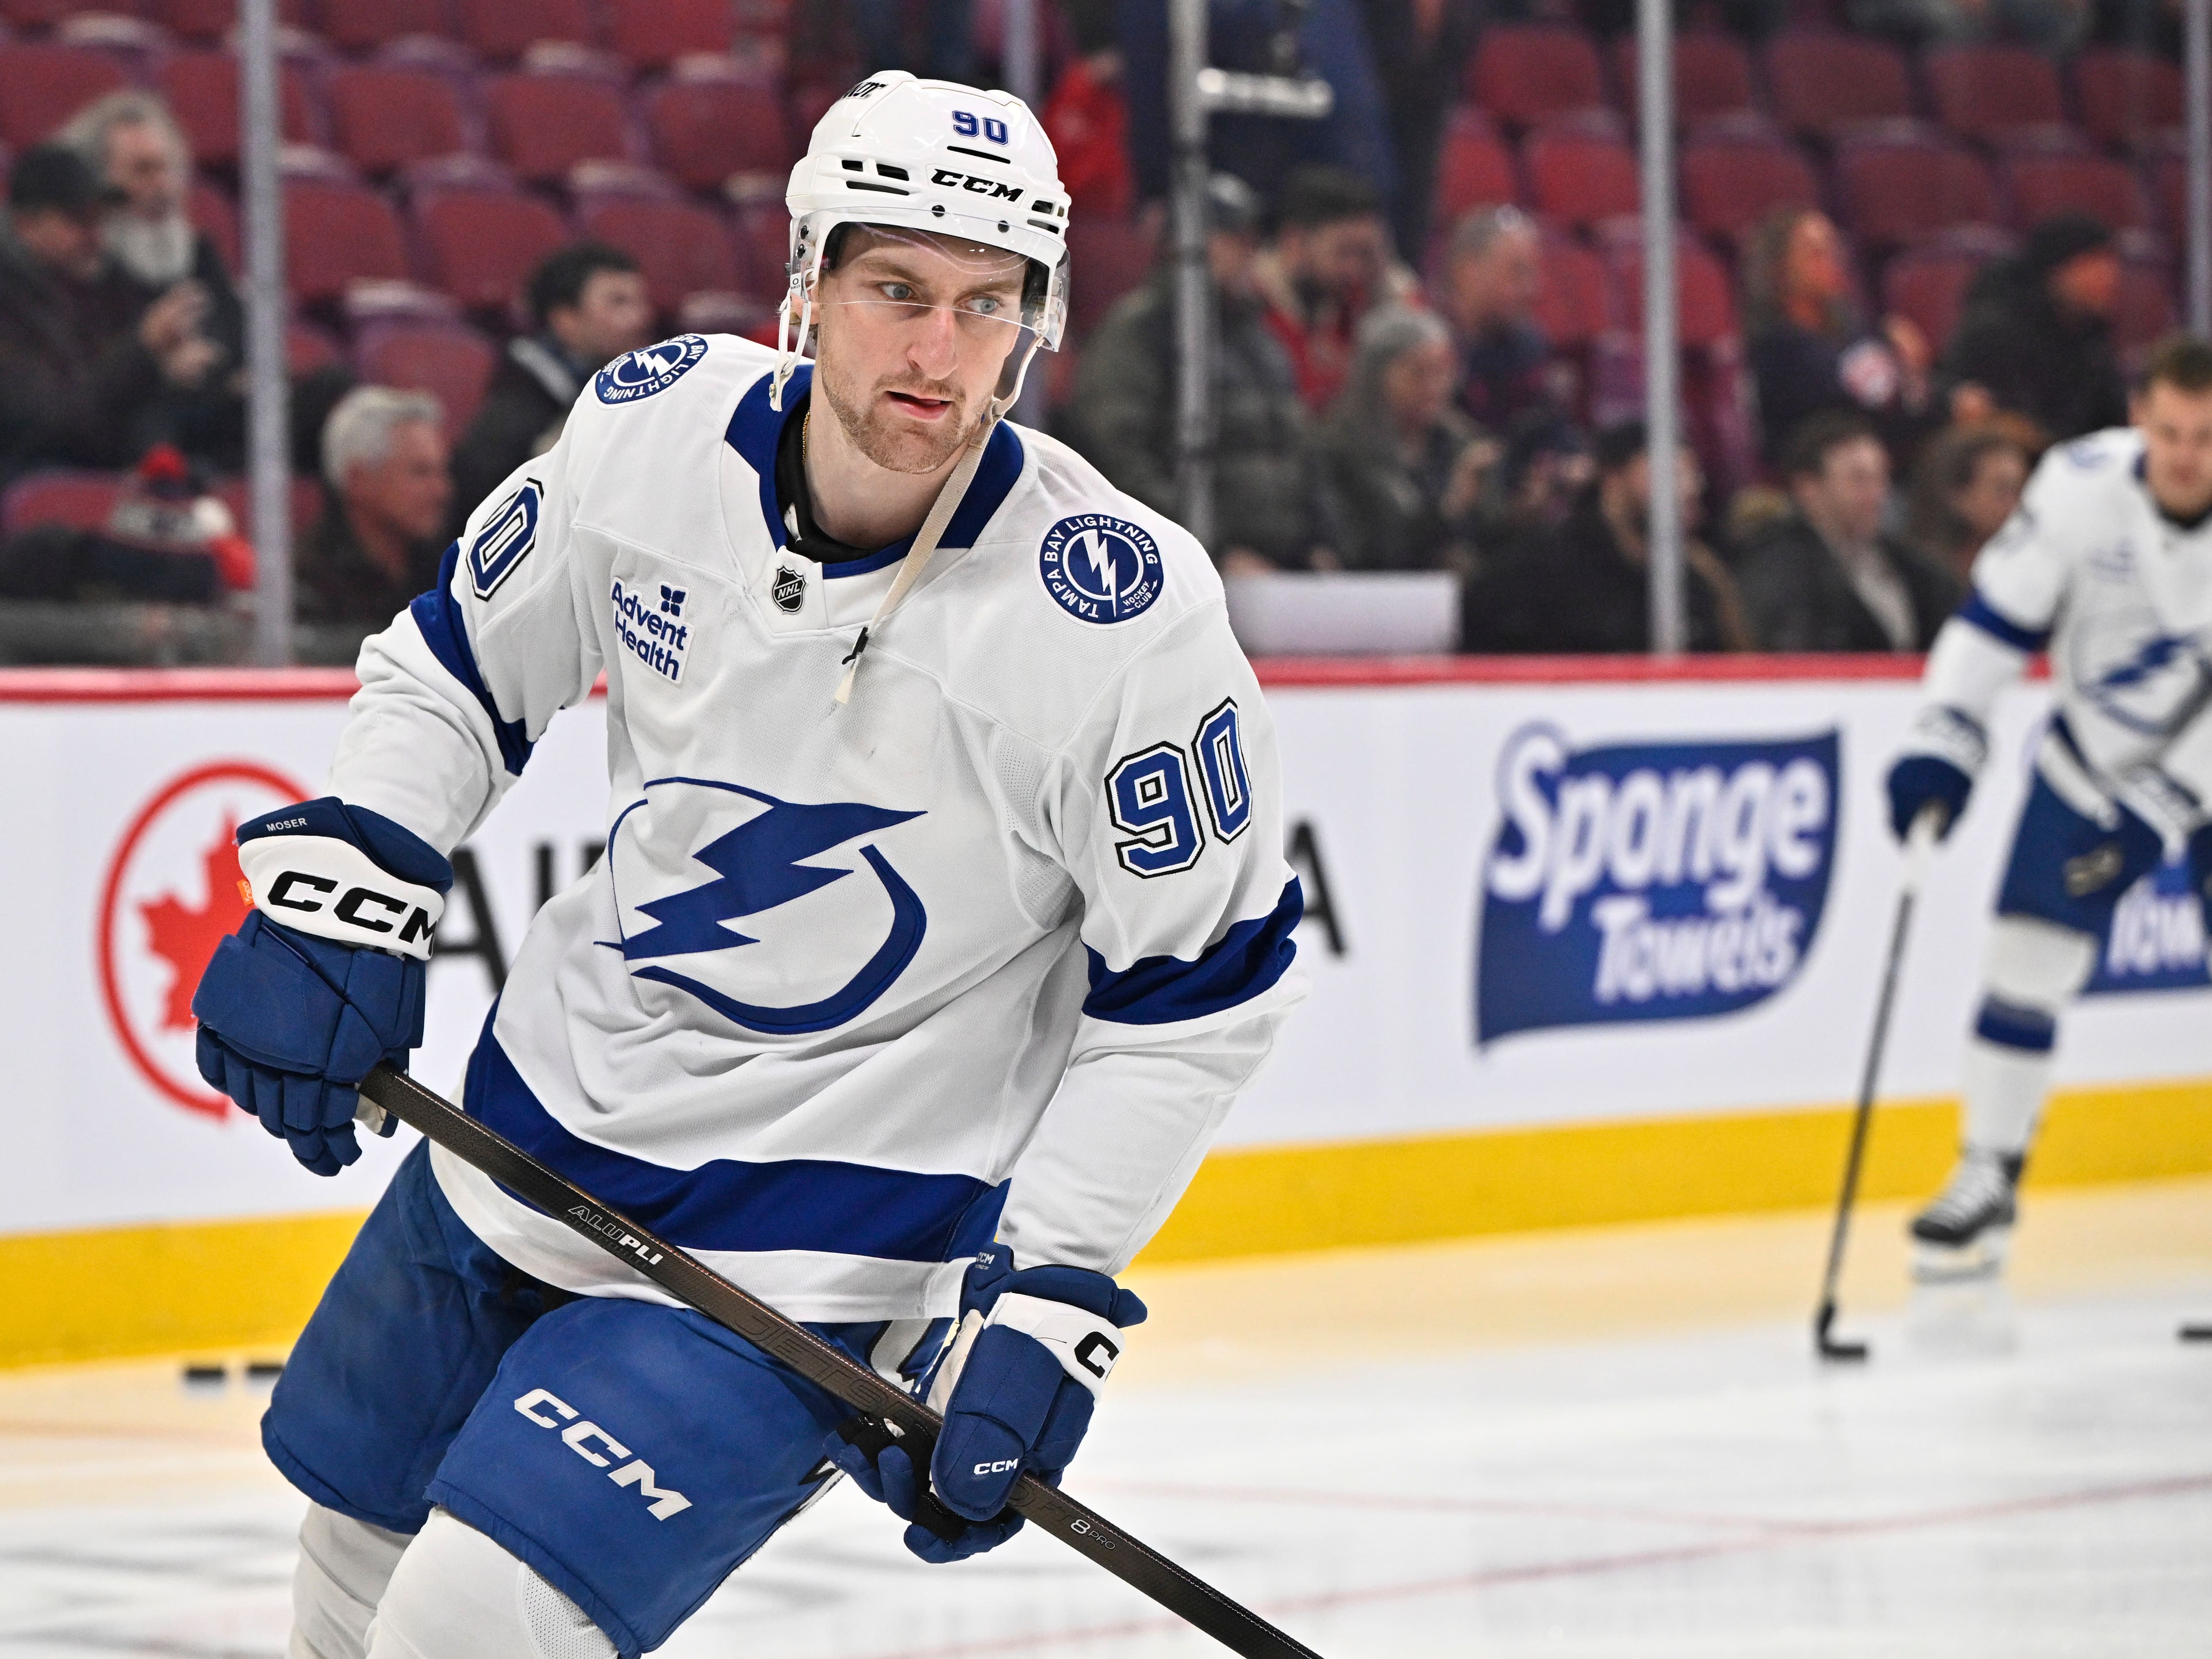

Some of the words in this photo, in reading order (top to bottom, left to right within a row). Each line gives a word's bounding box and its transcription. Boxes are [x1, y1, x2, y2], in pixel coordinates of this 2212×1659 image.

[952, 110, 1008, 146] 90
[930, 169, 1024, 202] CCM
[687, 345, 704, 360] BAY
[604, 364, 689, 399] LIGHTNING
[466, 477, 544, 602] 0
[1045, 529, 1065, 562] BAY
[1065, 516, 1158, 564] LIGHTNING
[777, 583, 800, 599] NHL
[1047, 568, 1098, 618] TAMPA
[1122, 581, 1150, 607] HOCKEY
[1134, 592, 1153, 609] CLUB
[611, 582, 687, 651] Advent
[615, 611, 679, 680] Health
[1104, 696, 1252, 879] 90
[266, 817, 307, 832] MOSER
[1490, 732, 1829, 932] Sponge
[268, 871, 435, 957] CCM
[1594, 889, 1804, 1003] Towels
[568, 1205, 663, 1265] ALUPLI
[514, 1389, 693, 1521] CCM
[974, 1458, 1018, 1475] CCM
[1088, 1530, 1115, 1549] PRO
